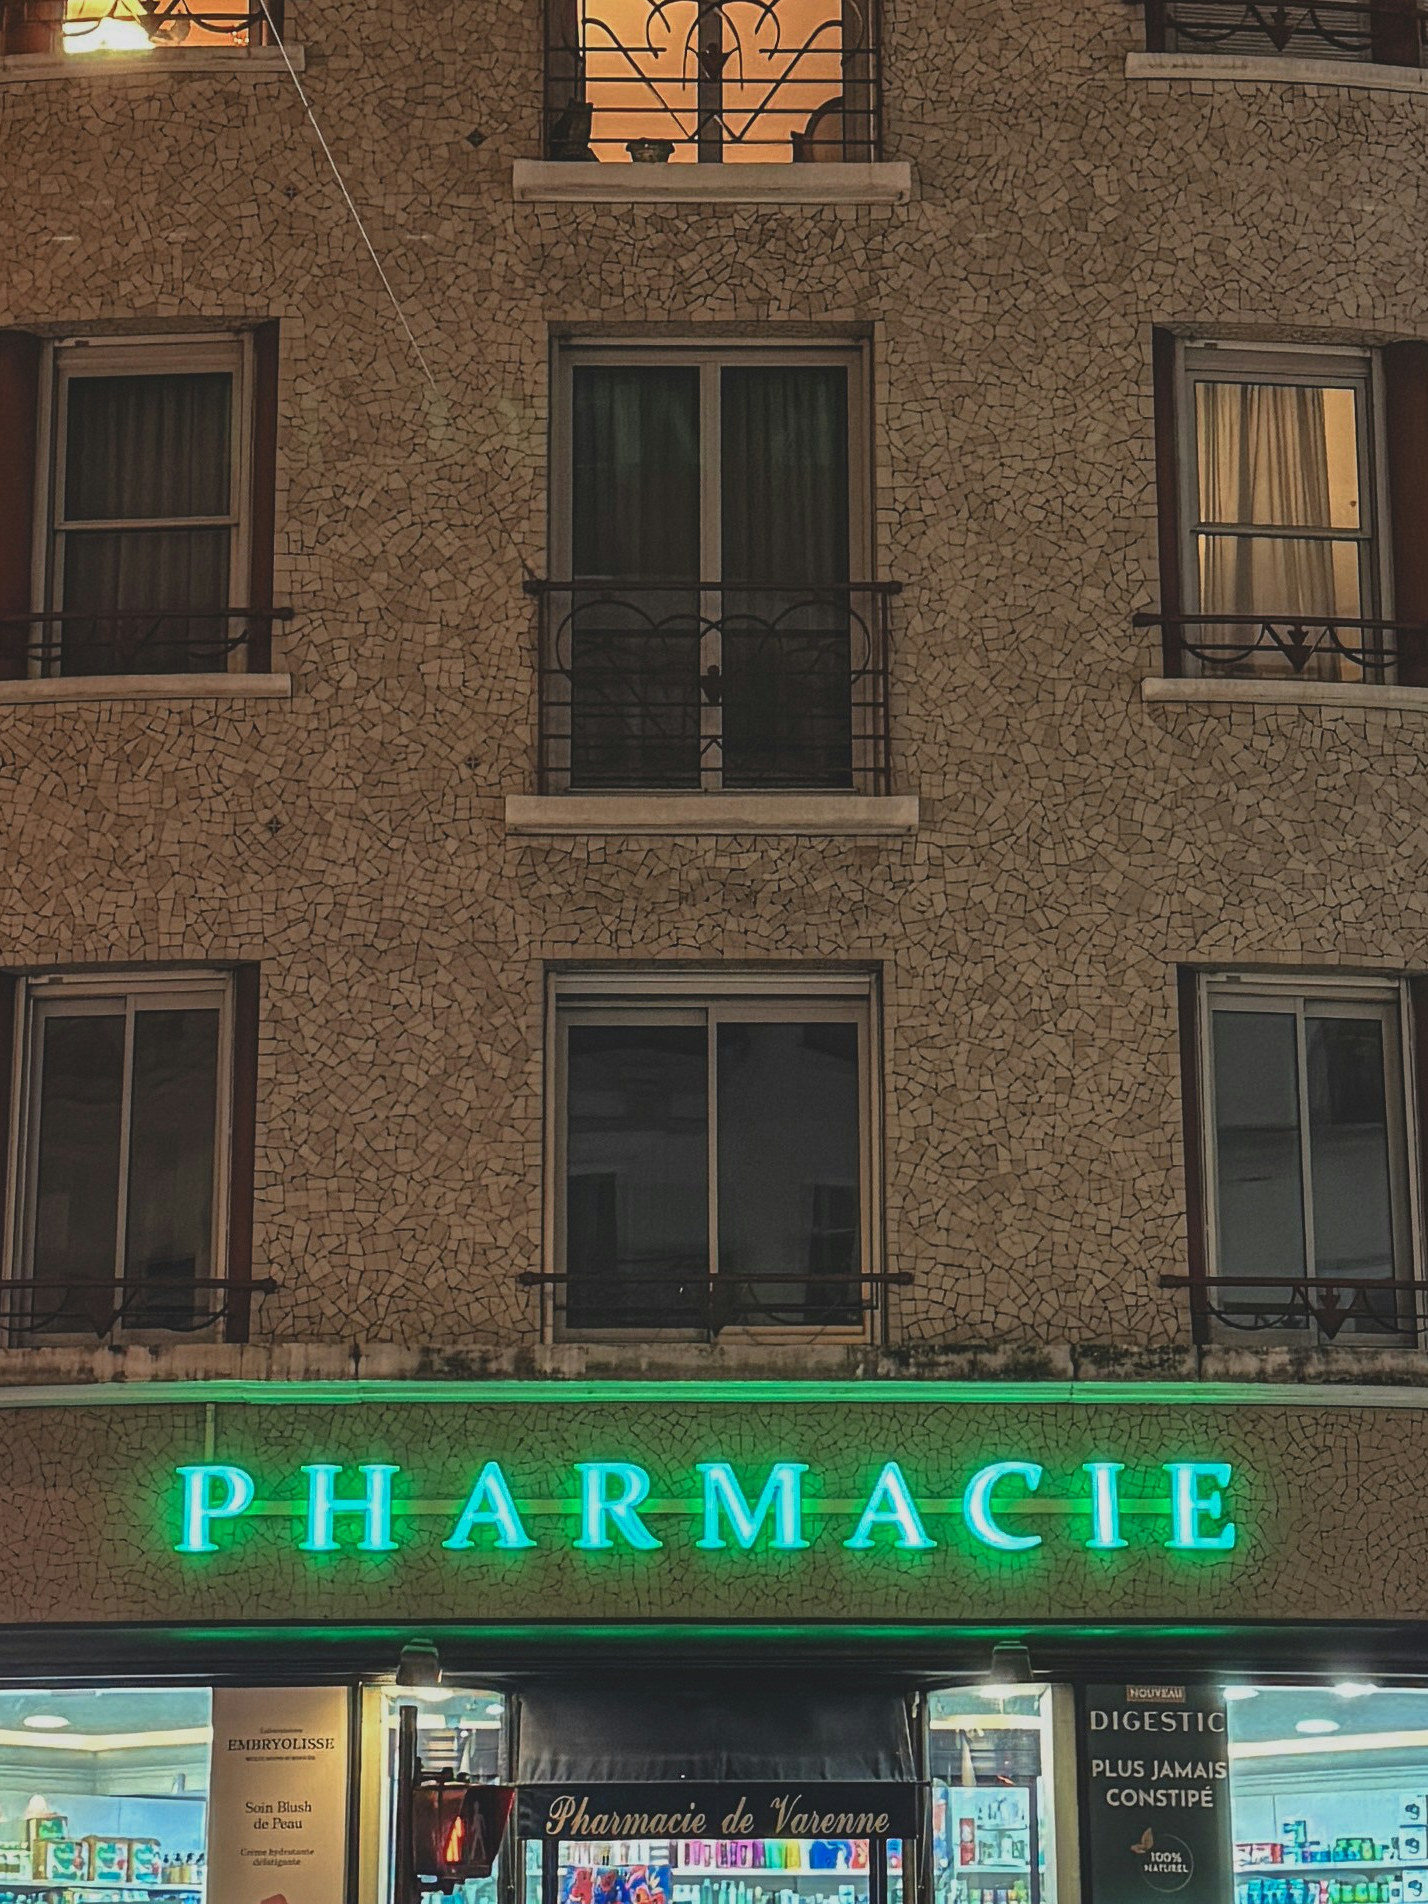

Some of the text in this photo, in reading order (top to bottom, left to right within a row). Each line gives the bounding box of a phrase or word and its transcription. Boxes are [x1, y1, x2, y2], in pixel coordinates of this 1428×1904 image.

[174, 1460, 1236, 1552] PHARMACIE
[1129, 1688, 1183, 1698] NOUVEAU
[1090, 1710, 1225, 1732] DIGESTIC
[228, 1738, 334, 1751] EMBRYOLISSE
[1092, 1759, 1228, 1780] PLUS JAMAIS
[1106, 1786, 1213, 1808] CONSTIPÉ
[245, 1801, 312, 1814] Soin Blush
[546, 1794, 890, 1835] Pharmacie de Varenne
[254, 1817, 303, 1830] de Peau
[1150, 1852, 1182, 1863] 100%
